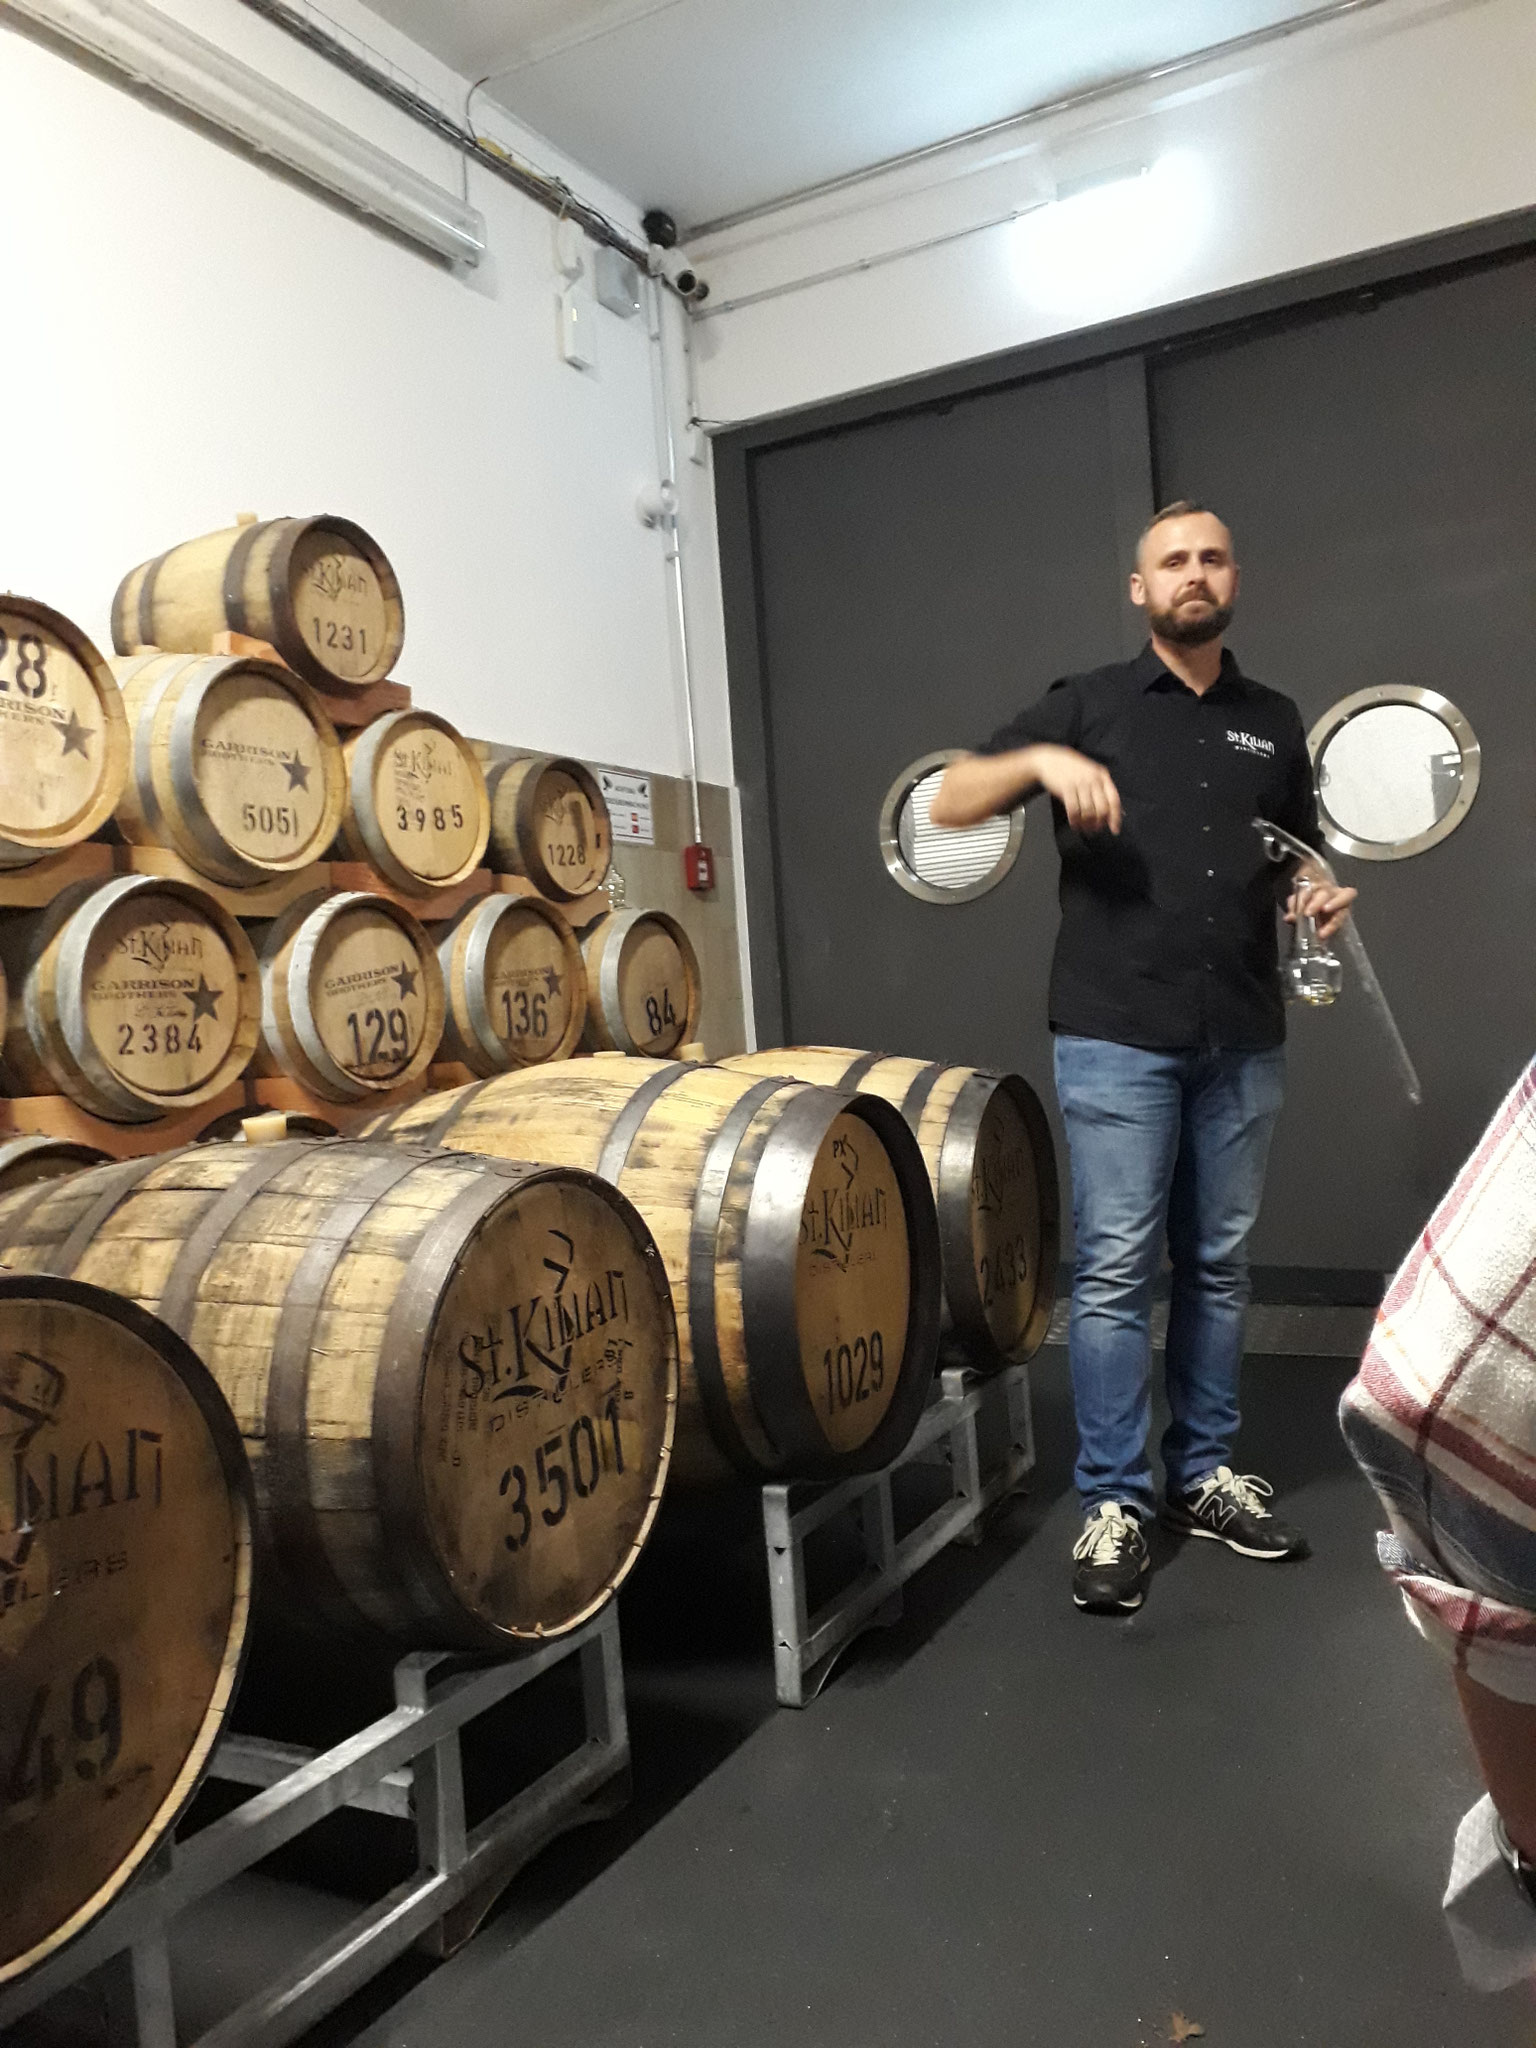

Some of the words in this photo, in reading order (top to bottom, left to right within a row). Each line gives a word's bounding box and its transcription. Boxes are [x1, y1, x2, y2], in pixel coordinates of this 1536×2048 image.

[313, 617, 366, 655] 1231
[243, 803, 298, 837] 5051
[396, 804, 463, 832] 3985
[548, 844, 586, 867] 1228
[89, 978, 195, 991] GARRISON
[325, 965, 400, 989] GARRISON
[502, 989, 548, 1040] 136
[646, 988, 676, 1036] 84
[118, 1023, 203, 1055] 2384
[347, 1008, 408, 1067] 129
[823, 1330, 884, 1415] 1029
[500, 1394, 625, 1552] 3501
